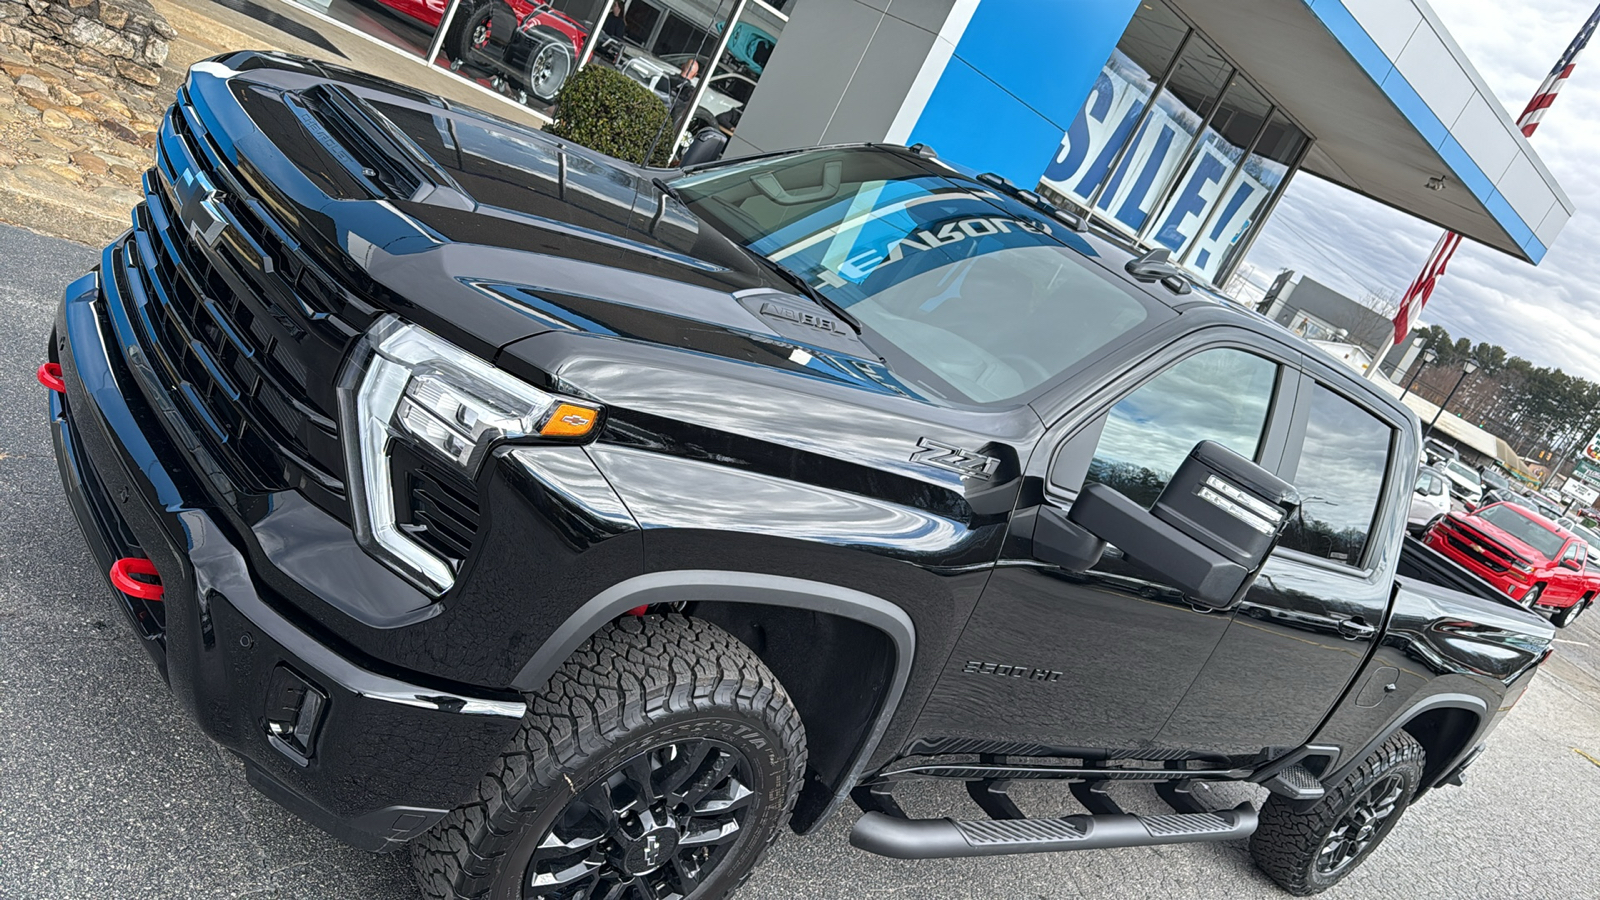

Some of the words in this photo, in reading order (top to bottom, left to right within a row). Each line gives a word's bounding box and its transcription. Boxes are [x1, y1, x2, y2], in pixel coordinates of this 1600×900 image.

[301, 113, 354, 163] CHEVROLET
[1043, 70, 1255, 270] SALE!
[908, 436, 1001, 482] Z71
[1029, 668, 1064, 683] HD
